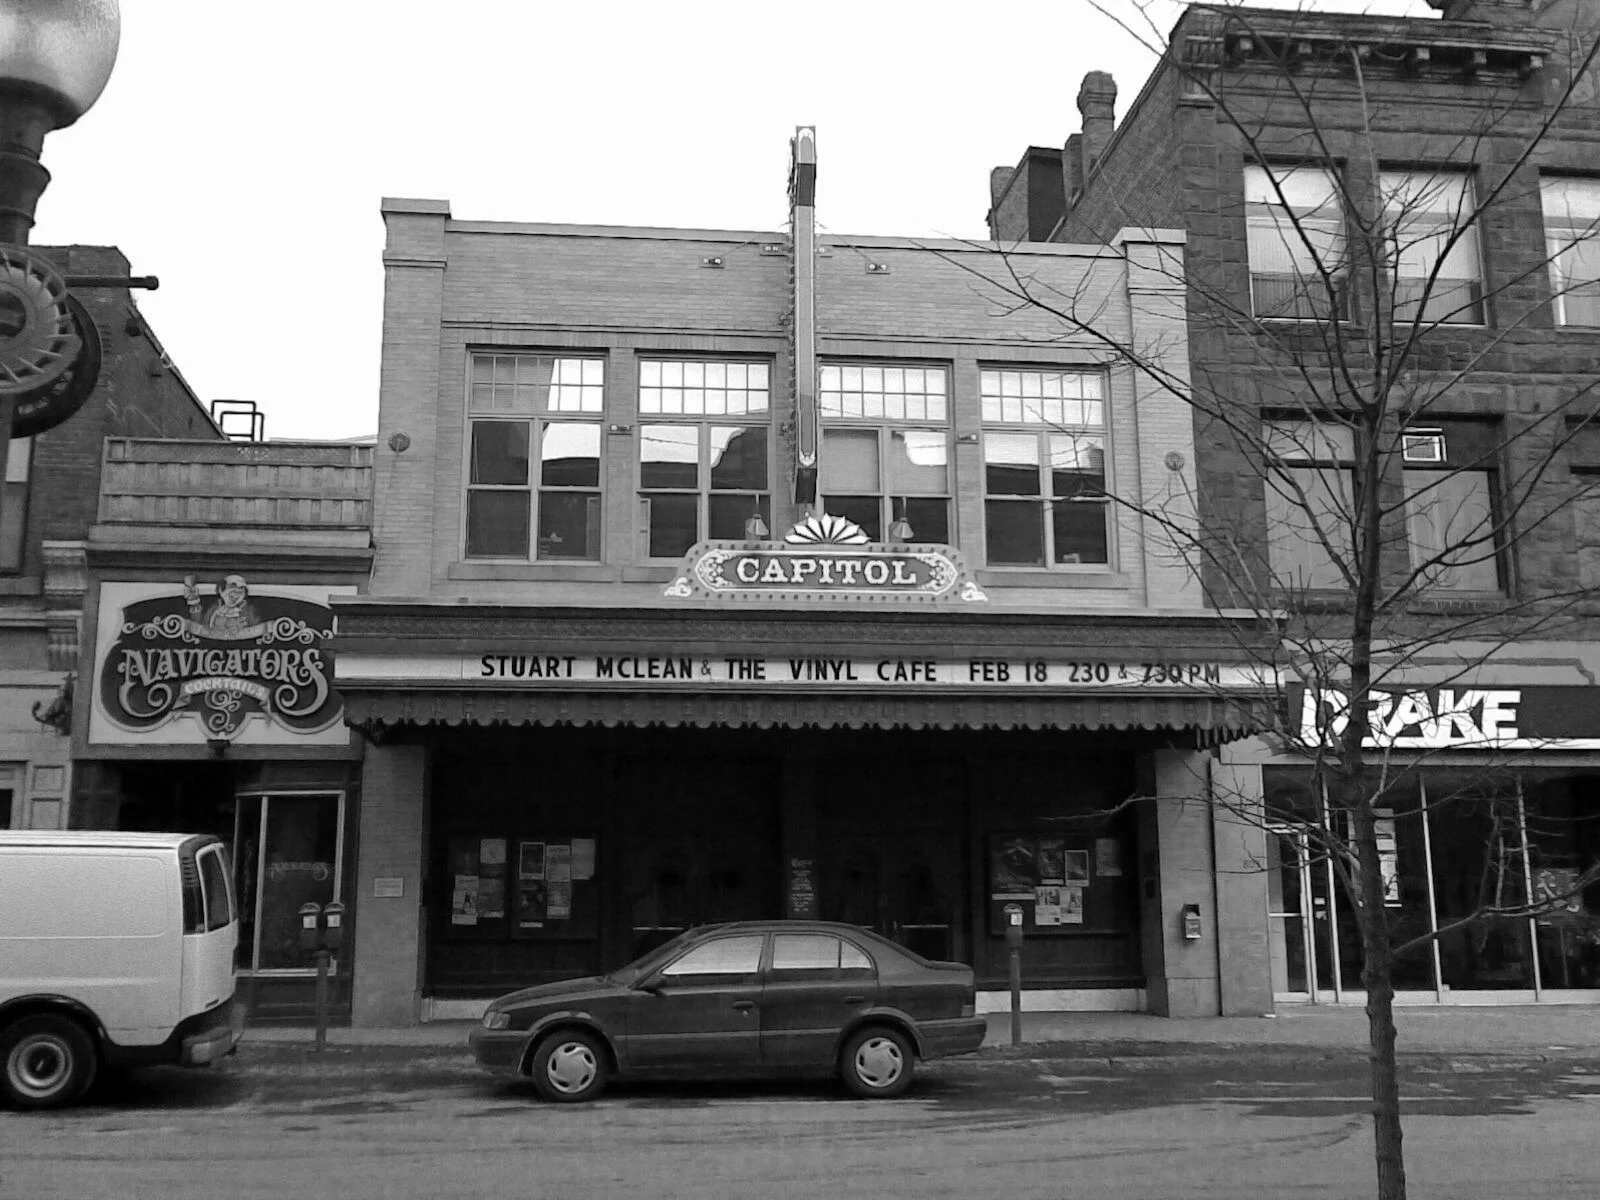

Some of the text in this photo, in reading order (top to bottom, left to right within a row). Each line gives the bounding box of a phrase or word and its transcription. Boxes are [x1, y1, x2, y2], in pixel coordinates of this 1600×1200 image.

[736, 557, 917, 586] CAPITOL
[117, 648, 329, 715] NAVIGATORS
[481, 655, 577, 678] STUART
[596, 657, 693, 679] MCLEAN
[700, 659, 712, 677] &
[725, 658, 766, 680] THE
[789, 659, 858, 681] VINYL
[877, 660, 937, 682] CAFE
[969, 661, 1010, 683] FEB
[1025, 661, 1048, 683] 18
[1068, 661, 1110, 683] 230
[184, 677, 266, 698] COCKTAILS
